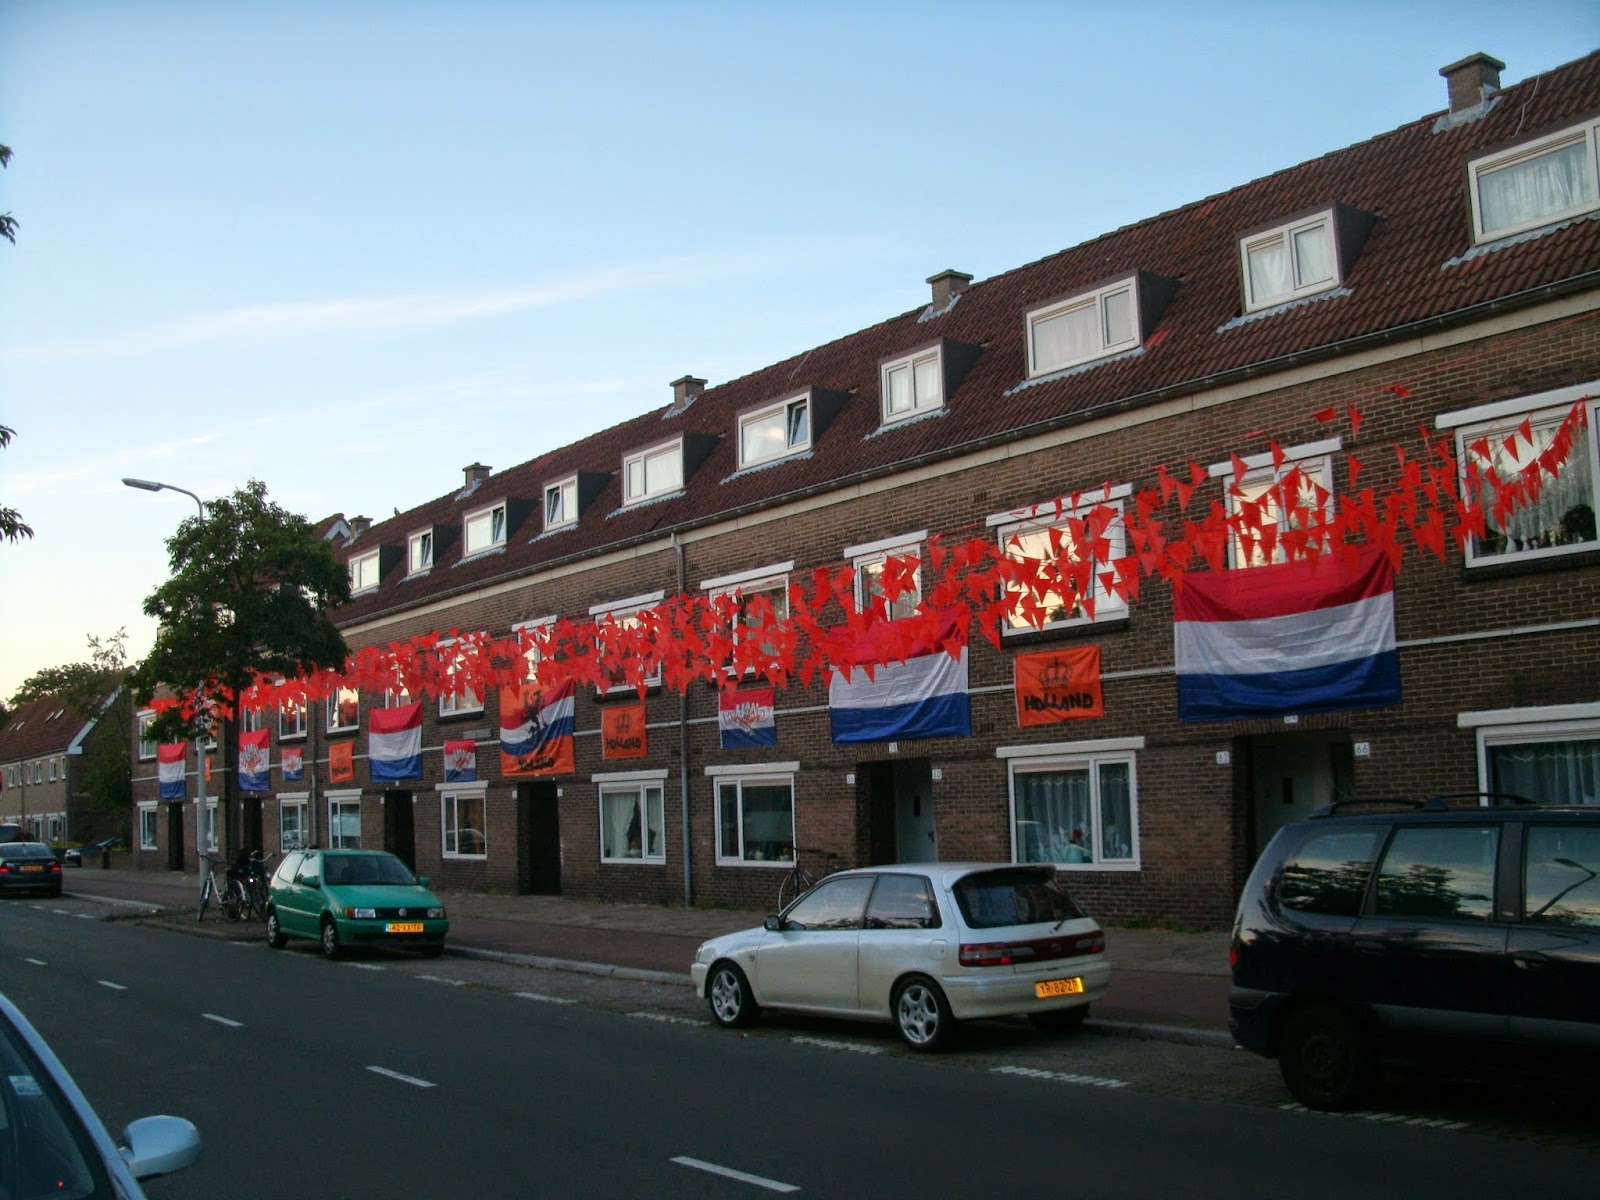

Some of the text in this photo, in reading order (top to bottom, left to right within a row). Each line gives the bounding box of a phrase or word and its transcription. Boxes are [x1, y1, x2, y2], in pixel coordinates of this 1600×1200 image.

[1024, 692, 1094, 712] HOLLAND
[606, 736, 641, 750] HOLLAND
[1356, 744, 1368, 754] 66
[1218, 752, 1228, 763] 62
[1039, 979, 1078, 995] YR-82-ZP
